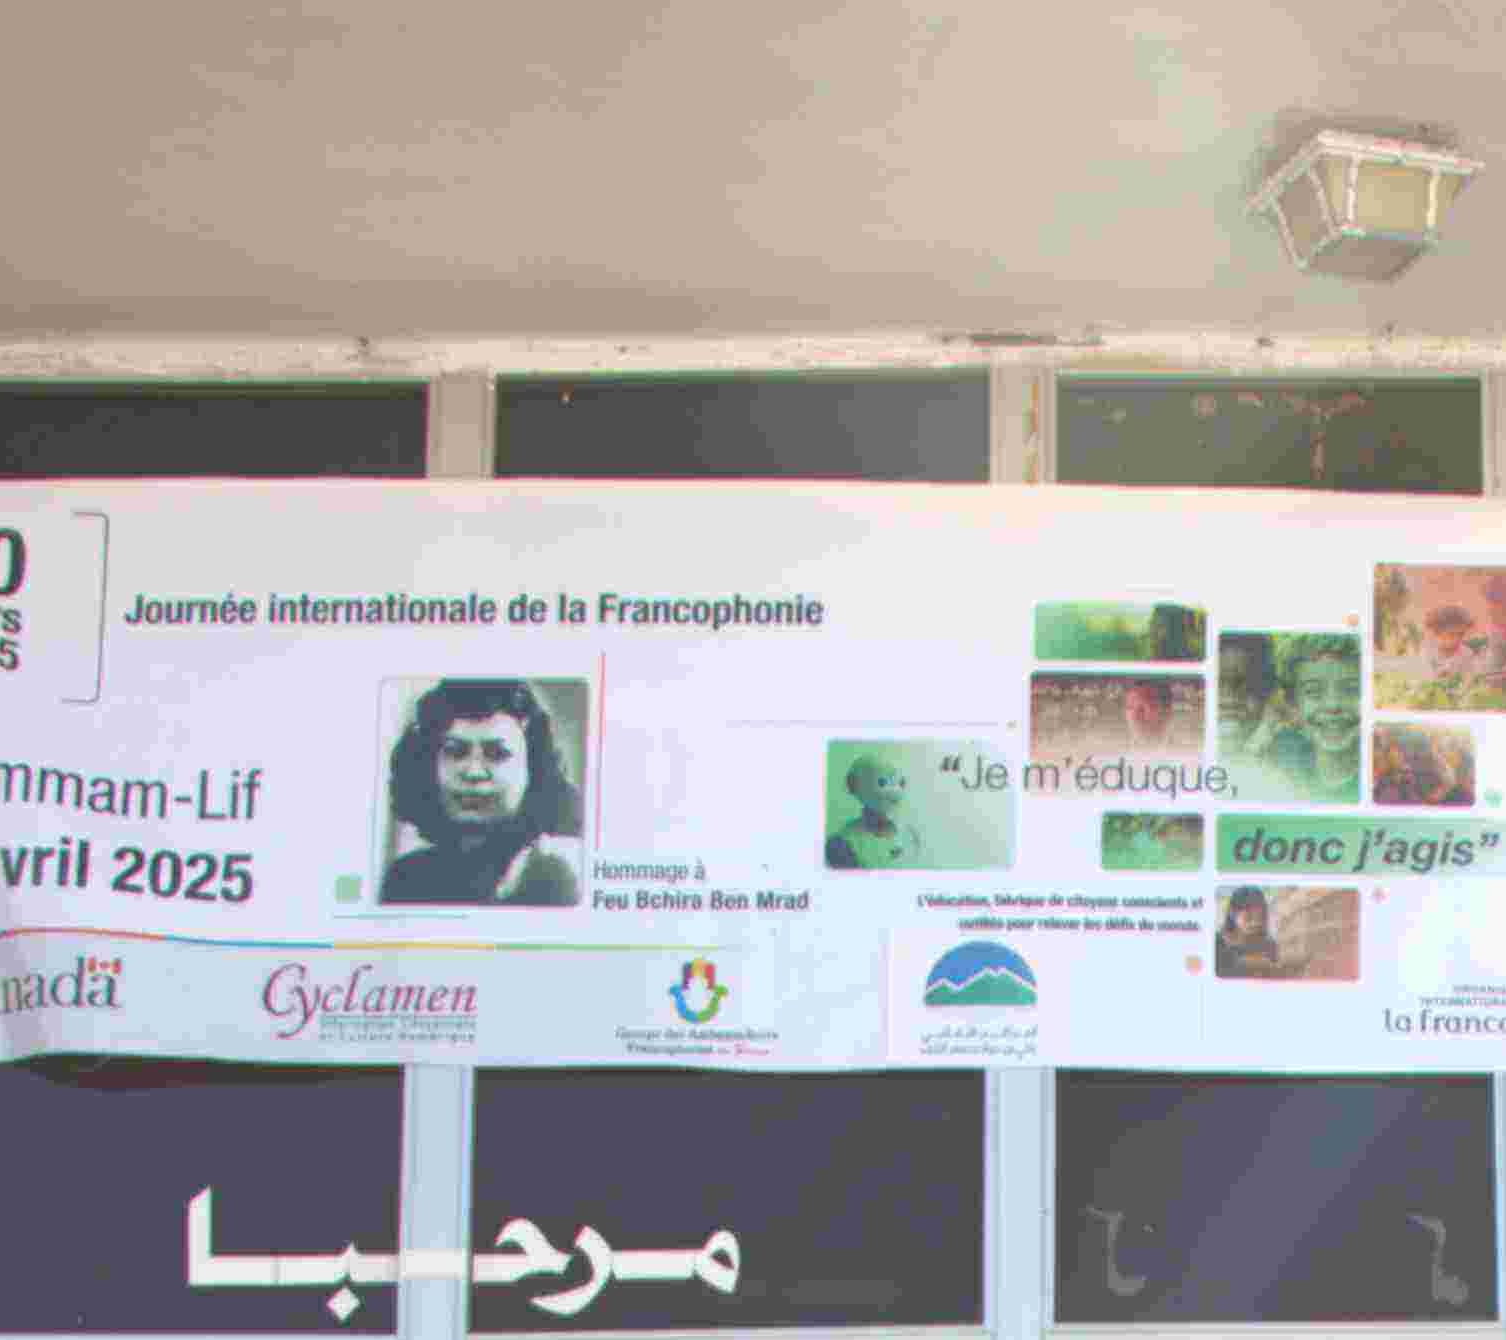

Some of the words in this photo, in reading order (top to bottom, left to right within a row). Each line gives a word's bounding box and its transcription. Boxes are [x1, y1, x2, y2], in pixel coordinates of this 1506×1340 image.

[125, 590, 258, 626] Journée
[269, 591, 498, 626] internationale
[507, 592, 548, 626] de
[557, 592, 588, 626] la
[598, 592, 825, 631] Francophonie
[1022, 757, 1240, 800] m'éduque,
[1232, 826, 1346, 865] donc
[110, 845, 255, 903] 2025
[593, 860, 689, 883] Hommage
[693, 857, 707, 881] à
[592, 889, 630, 910] Feu
[635, 888, 704, 911] Bchira
[709, 889, 750, 911] Ben
[756, 890, 811, 911] Mrad
[261, 962, 479, 1041] Cyclamen
[1382, 1008, 1412, 1033] la
[187, 1185, 741, 1321] مرحبا
